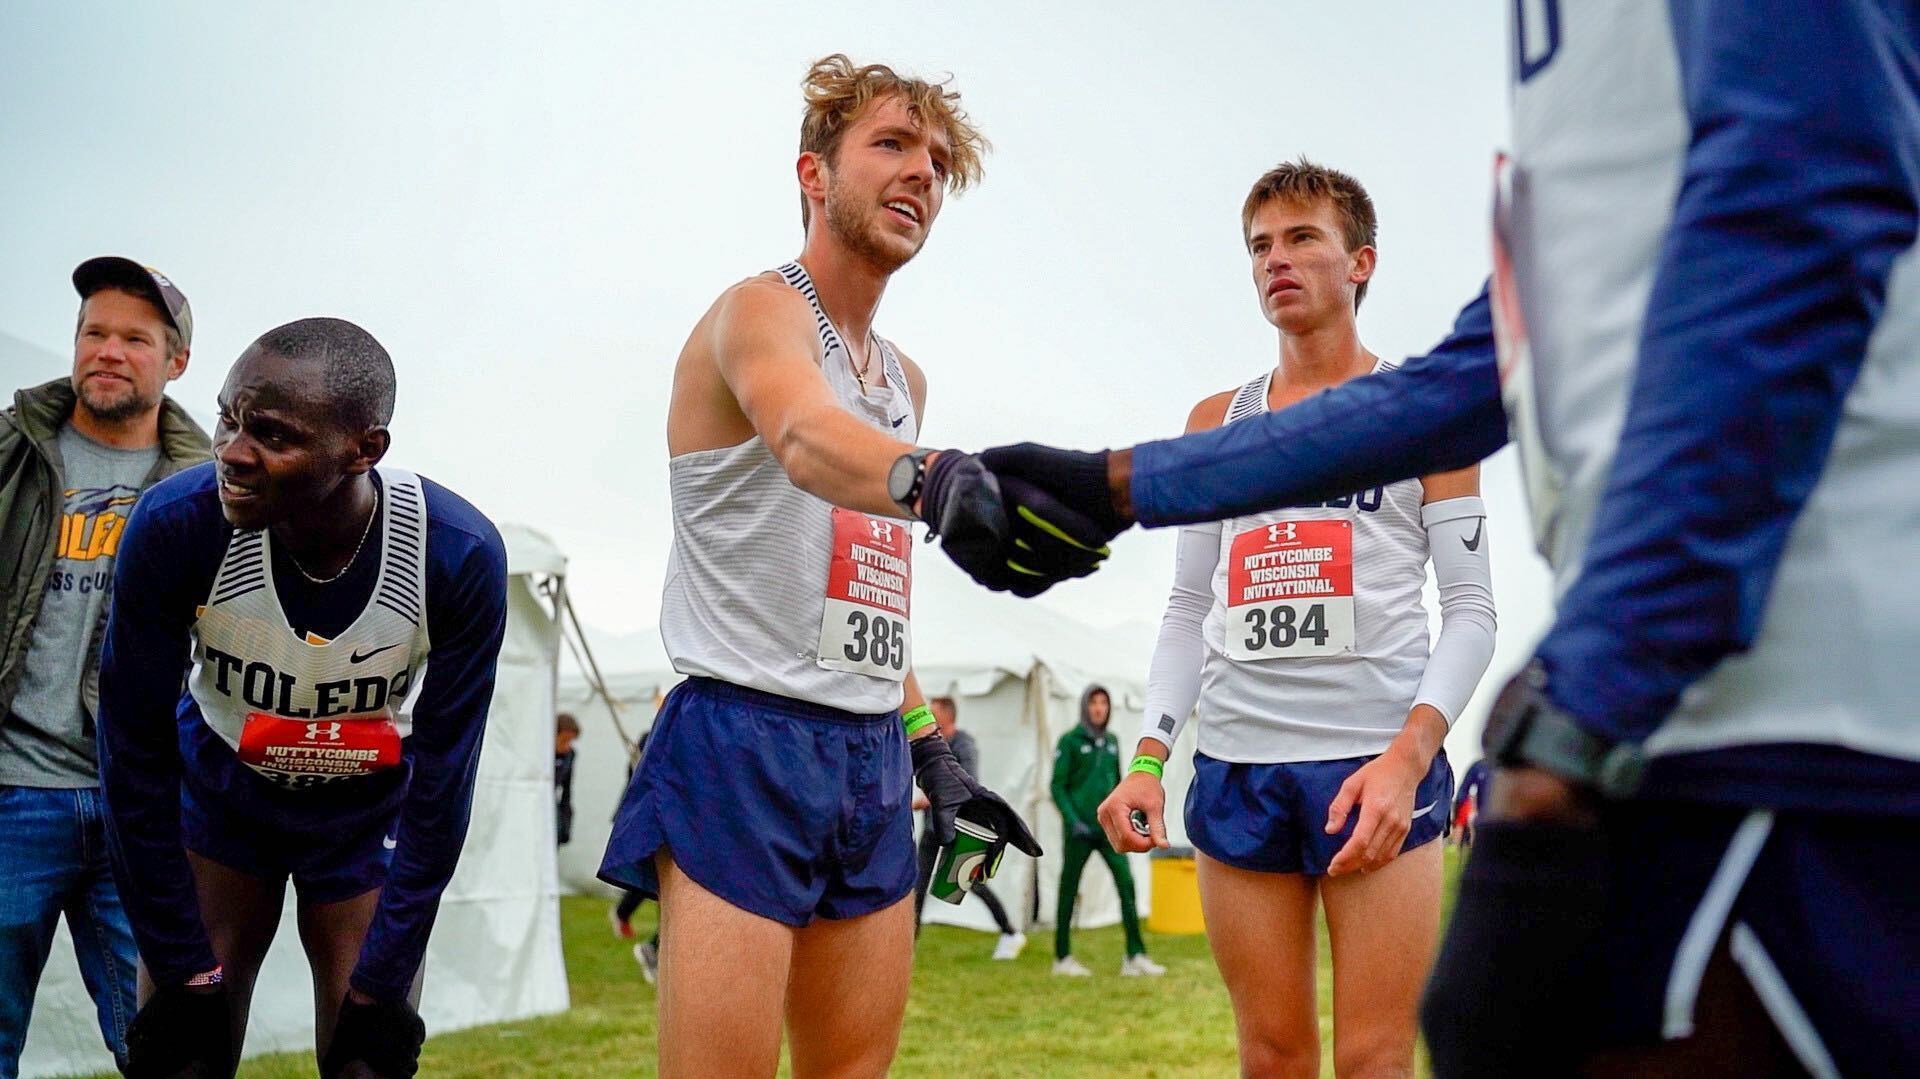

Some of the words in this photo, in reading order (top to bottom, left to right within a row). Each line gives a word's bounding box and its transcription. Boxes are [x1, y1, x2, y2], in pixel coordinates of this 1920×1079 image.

[1244, 547, 1333, 570] NUTTYCOMBE
[1250, 563, 1320, 584] WISCONSIN
[1243, 578, 1334, 601] INVITATIONAL
[1244, 604, 1329, 651] 384
[844, 610, 904, 671] 385
[265, 746, 379, 762] NUTTYCOMBE
[274, 757, 361, 769] WISCONSIN
